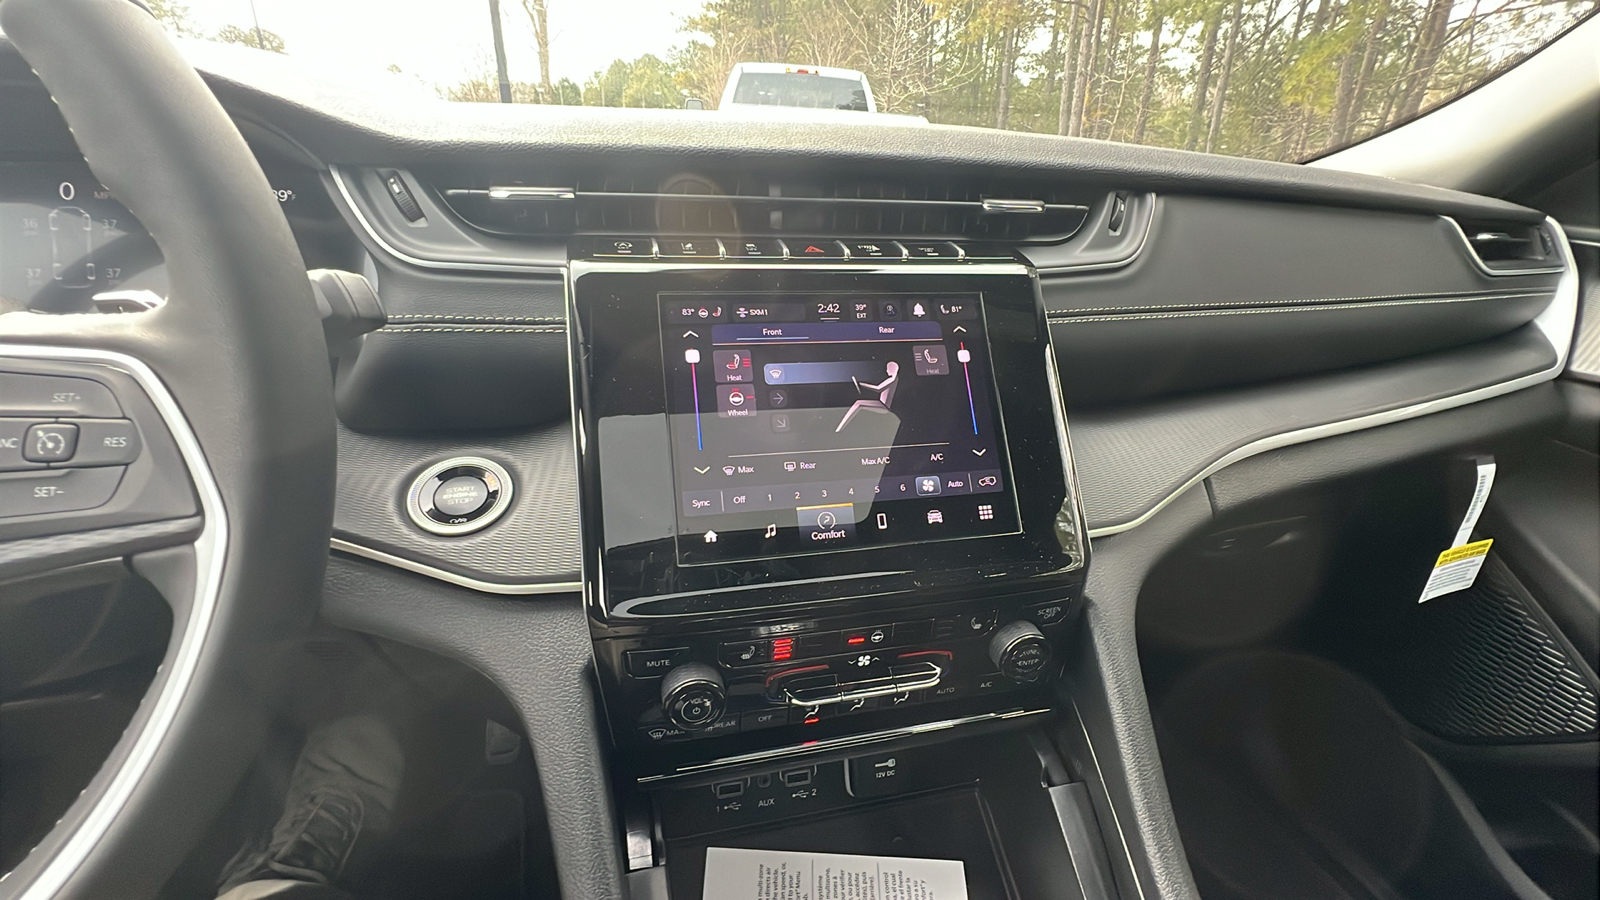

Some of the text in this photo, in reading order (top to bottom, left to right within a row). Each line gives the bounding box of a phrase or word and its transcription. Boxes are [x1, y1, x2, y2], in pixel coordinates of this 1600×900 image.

[59, 182, 75, 201] 0
[103, 219, 118, 230] 37
[26, 268, 42, 279] 37
[106, 268, 122, 279] 37
[817, 303, 841, 314] 2:42
[855, 303, 867, 311] 39°
[951, 305, 963, 313] 81°
[681, 308, 695, 316] 83°
[762, 328, 783, 336] Front
[878, 326, 895, 334] Rear
[727, 409, 749, 417] Wheel
[103, 437, 127, 448] RES
[861, 456, 891, 466] Max A/C
[930, 453, 944, 462] A/C
[738, 465, 755, 473] Max
[800, 461, 817, 470] Rear
[446, 485, 476, 493] START
[733, 480, 964, 504] Off 1 2 3 4 5 6 Auto
[442, 491, 479, 500] ENGINE
[447, 497, 474, 506] STOP
[692, 499, 711, 508] Sync
[811, 529, 846, 541] Comfort
[1037, 606, 1061, 616] SCREEN
[1043, 611, 1058, 620] OFF
[646, 659, 670, 668] MUTE
[758, 715, 773, 723] OFF
[758, 798, 775, 808] AUX
